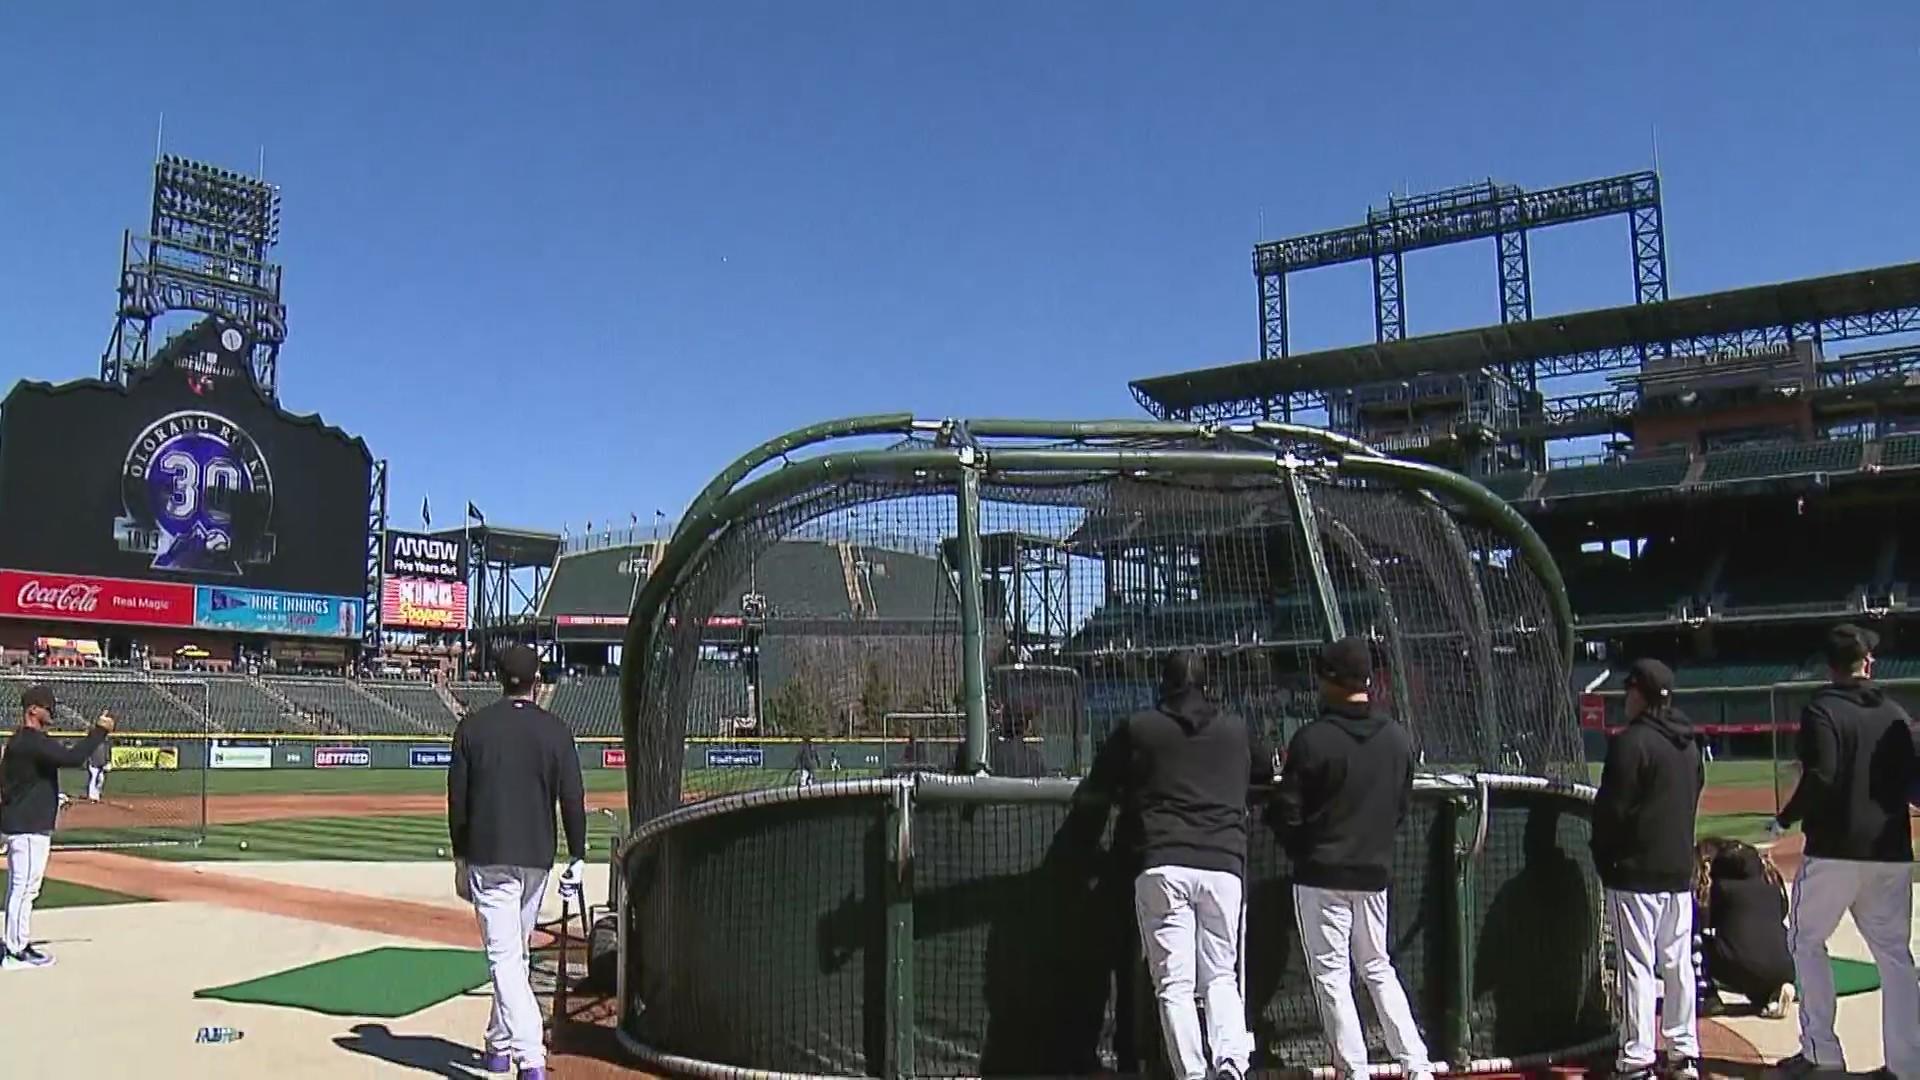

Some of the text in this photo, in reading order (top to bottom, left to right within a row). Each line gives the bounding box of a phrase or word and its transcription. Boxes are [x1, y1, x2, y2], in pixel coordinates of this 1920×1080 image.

[160, 449, 242, 521] 30
[394, 537, 459, 561] ARROW
[394, 559, 458, 575] Five Years Out
[17, 580, 103, 612] Coca-Cola
[113, 596, 170, 610] Real Magic
[251, 595, 329, 614] NINE INNINGS
